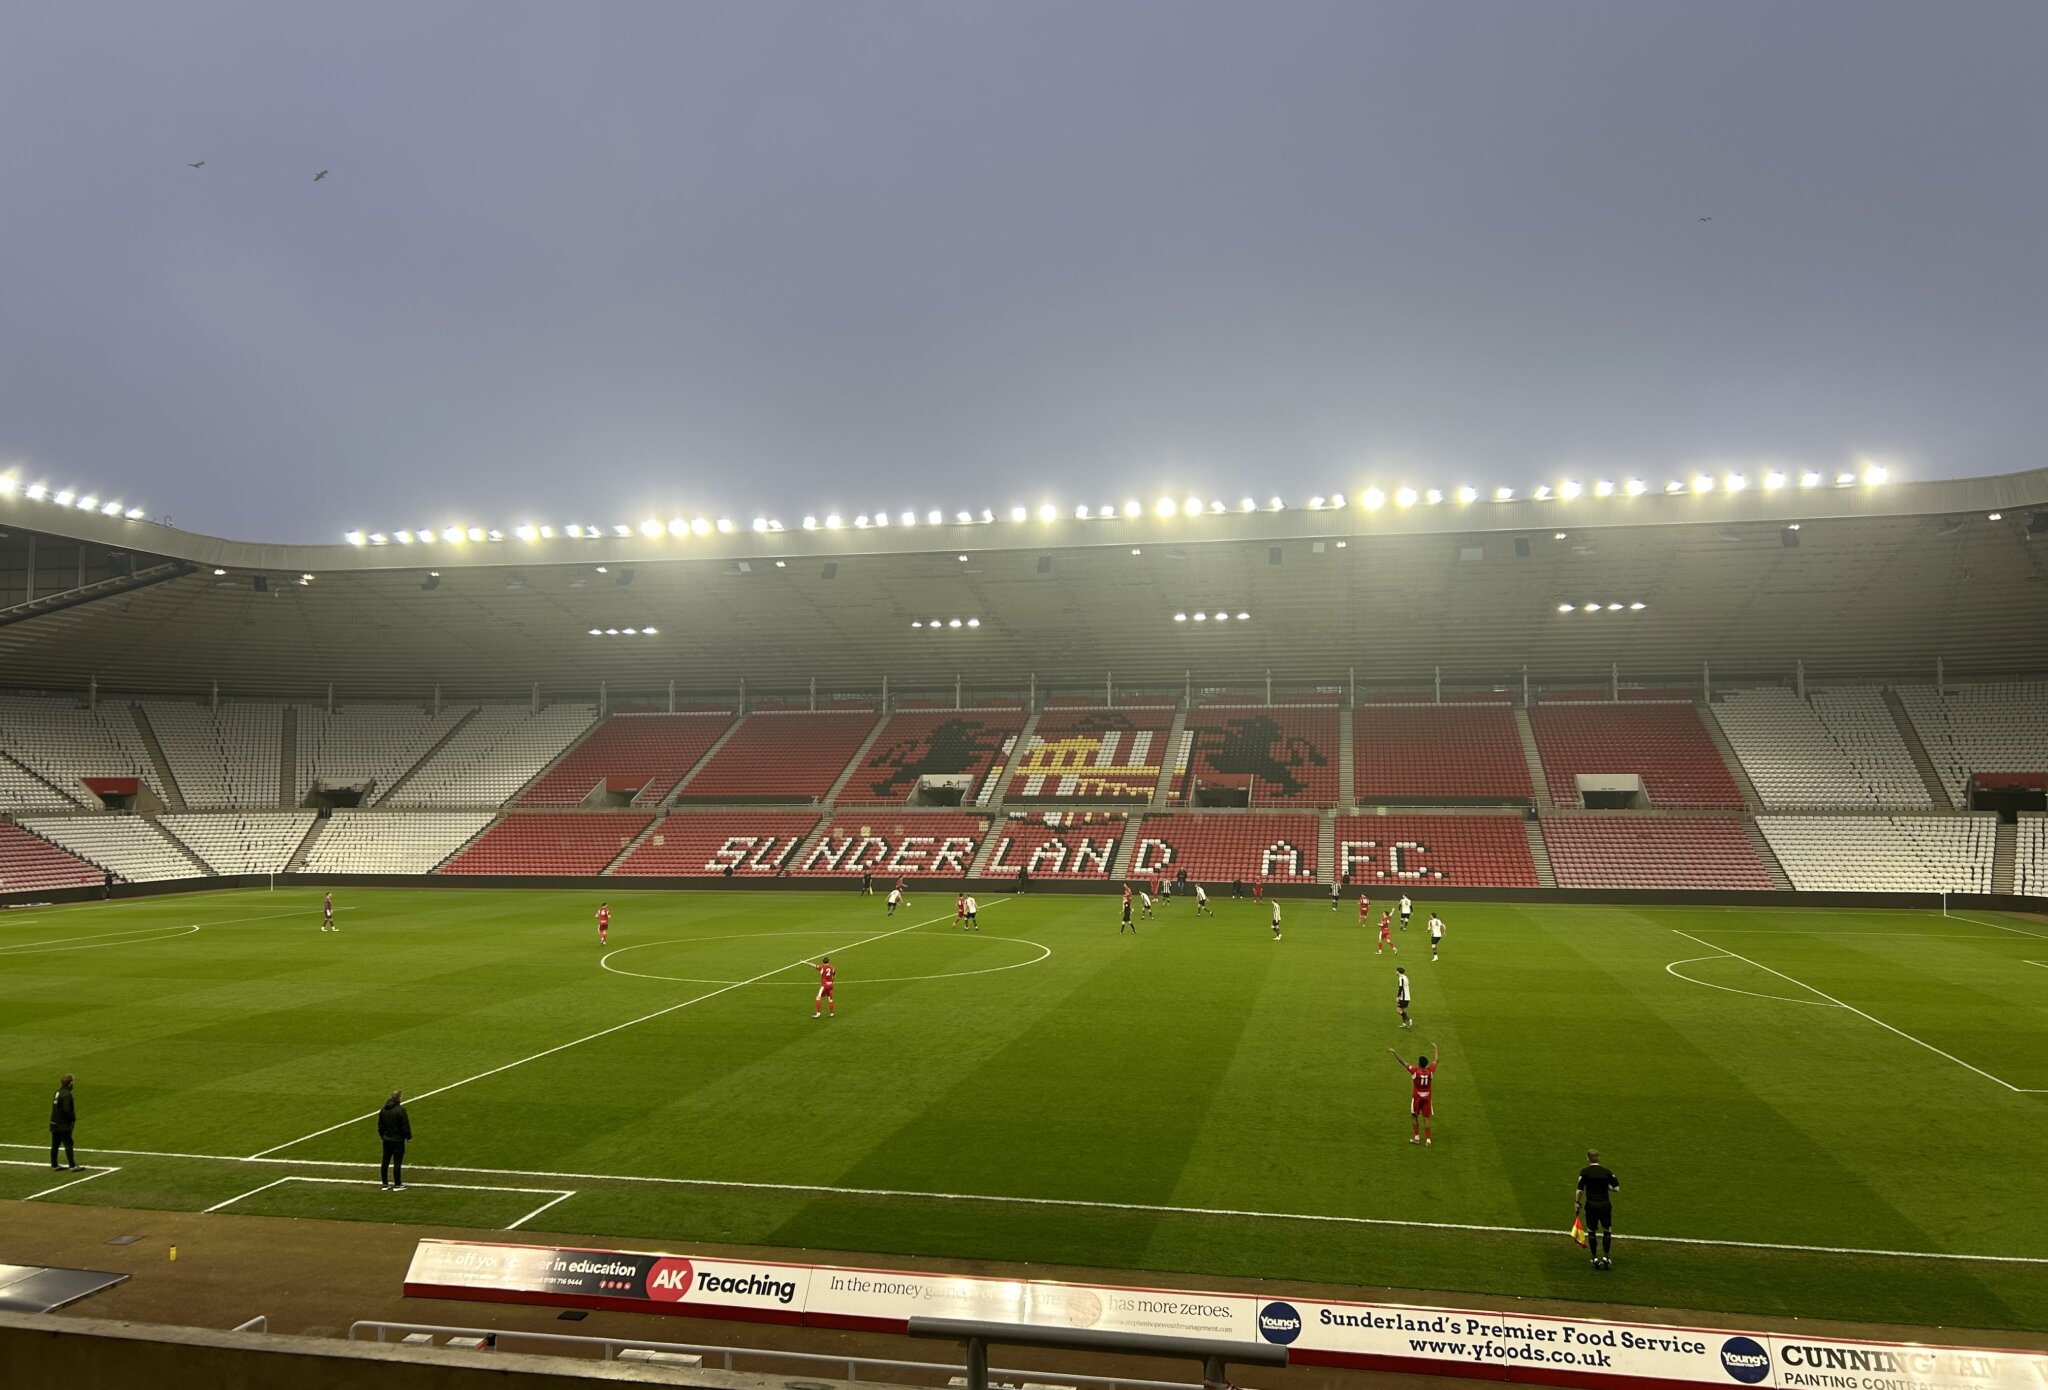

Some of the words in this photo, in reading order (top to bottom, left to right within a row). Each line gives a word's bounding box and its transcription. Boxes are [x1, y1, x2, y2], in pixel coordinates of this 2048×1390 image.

[704, 836, 1174, 874] SUNDERLAND
[553, 1257, 567, 1272] in
[568, 1258, 636, 1277] education
[652, 1269, 688, 1290] AK
[697, 1272, 796, 1304] Teaching
[830, 1276, 844, 1291] In
[847, 1276, 871, 1293] the
[873, 1282, 923, 1299] money
[1108, 1294, 1135, 1312] has
[1137, 1300, 1178, 1314] more
[1180, 1302, 1233, 1318] zeroes.
[1260, 1315, 1301, 1330] Young's
[1319, 1308, 1461, 1335] Sunderland's
[1466, 1318, 1558, 1342] Premier
[1562, 1326, 1617, 1347] Food
[1621, 1330, 1706, 1355] Service
[1409, 1338, 1612, 1367] www.yfoods.co.uk
[1721, 1350, 1769, 1367] Young's
[1780, 1344, 1999, 1379] CUNNINGAM
[1784, 1372, 1858, 1389] PAINTING
